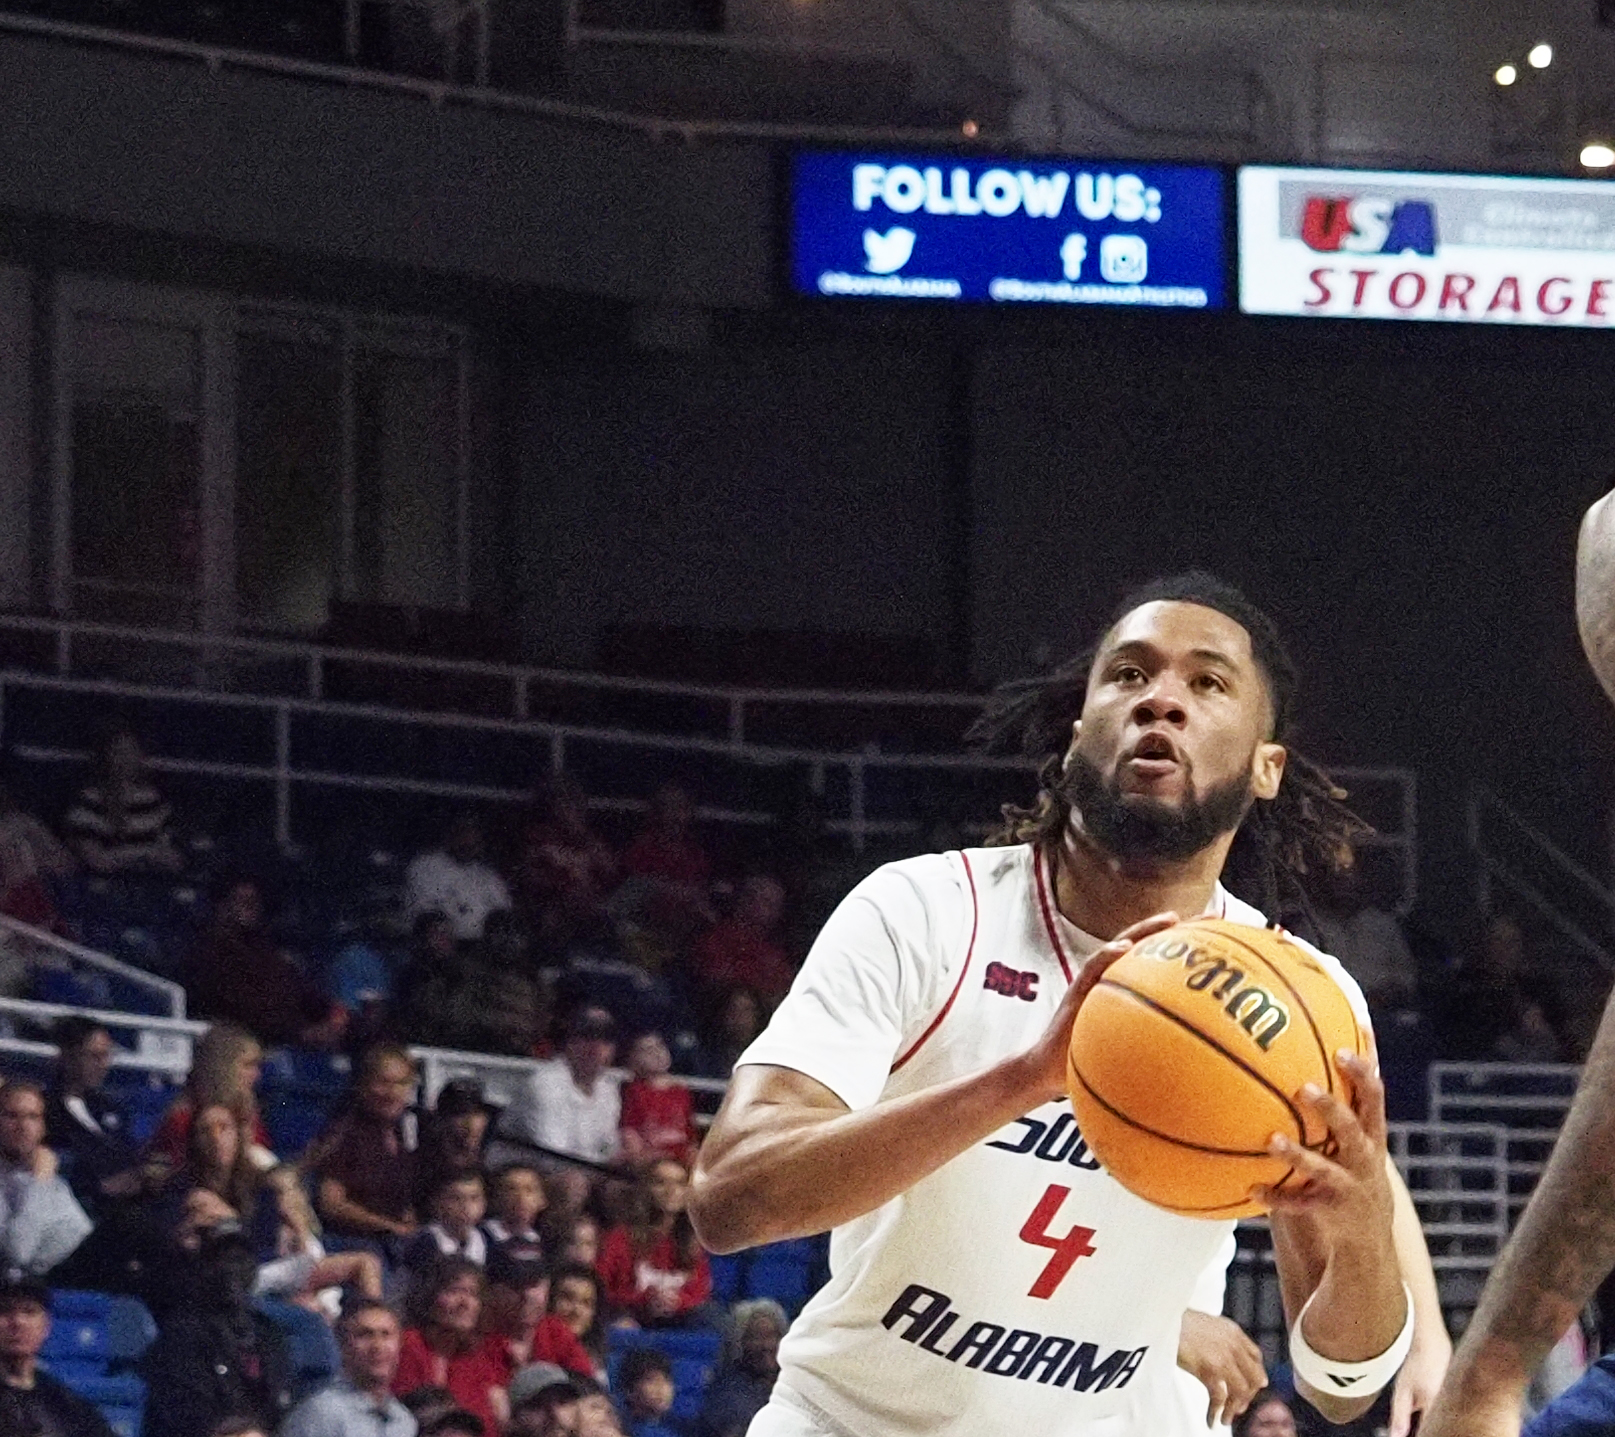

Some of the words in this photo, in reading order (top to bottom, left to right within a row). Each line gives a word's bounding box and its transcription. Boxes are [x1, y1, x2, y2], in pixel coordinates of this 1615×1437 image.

[852, 163, 1071, 218] FOLLOW
[1075, 171, 1163, 223] US:
[1302, 196, 1440, 257] USA
[1304, 267, 1614, 318] STORAGE
[1018, 1183, 1098, 1300] 4
